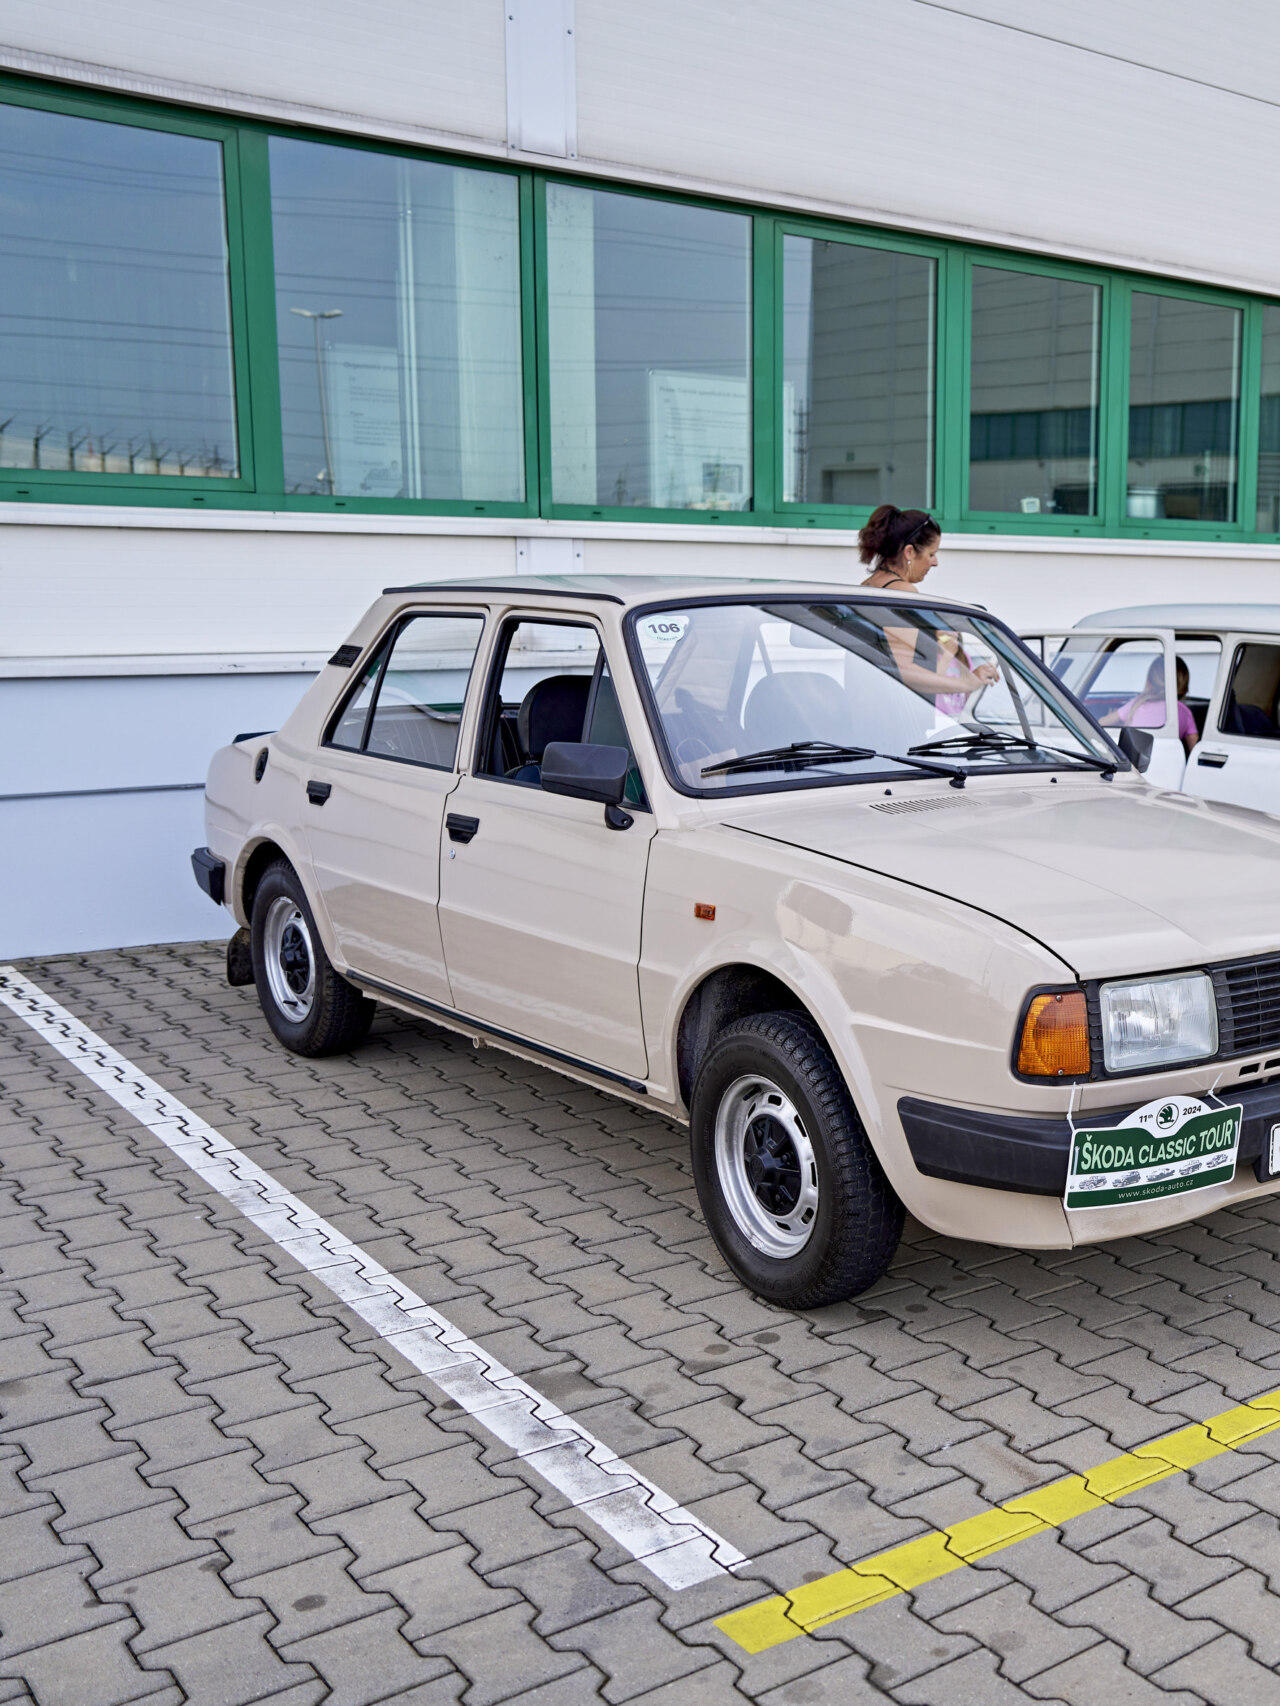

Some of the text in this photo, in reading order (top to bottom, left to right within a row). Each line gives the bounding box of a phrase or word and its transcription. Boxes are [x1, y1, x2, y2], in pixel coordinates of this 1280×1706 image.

[648, 623, 681, 634] 106
[1138, 1104, 1202, 1124] 11th 2024
[1080, 1118, 1233, 1171] ŠKODA CLASSIC TOUR
[1117, 1178, 1194, 1199] www.skoda-auto.cz
